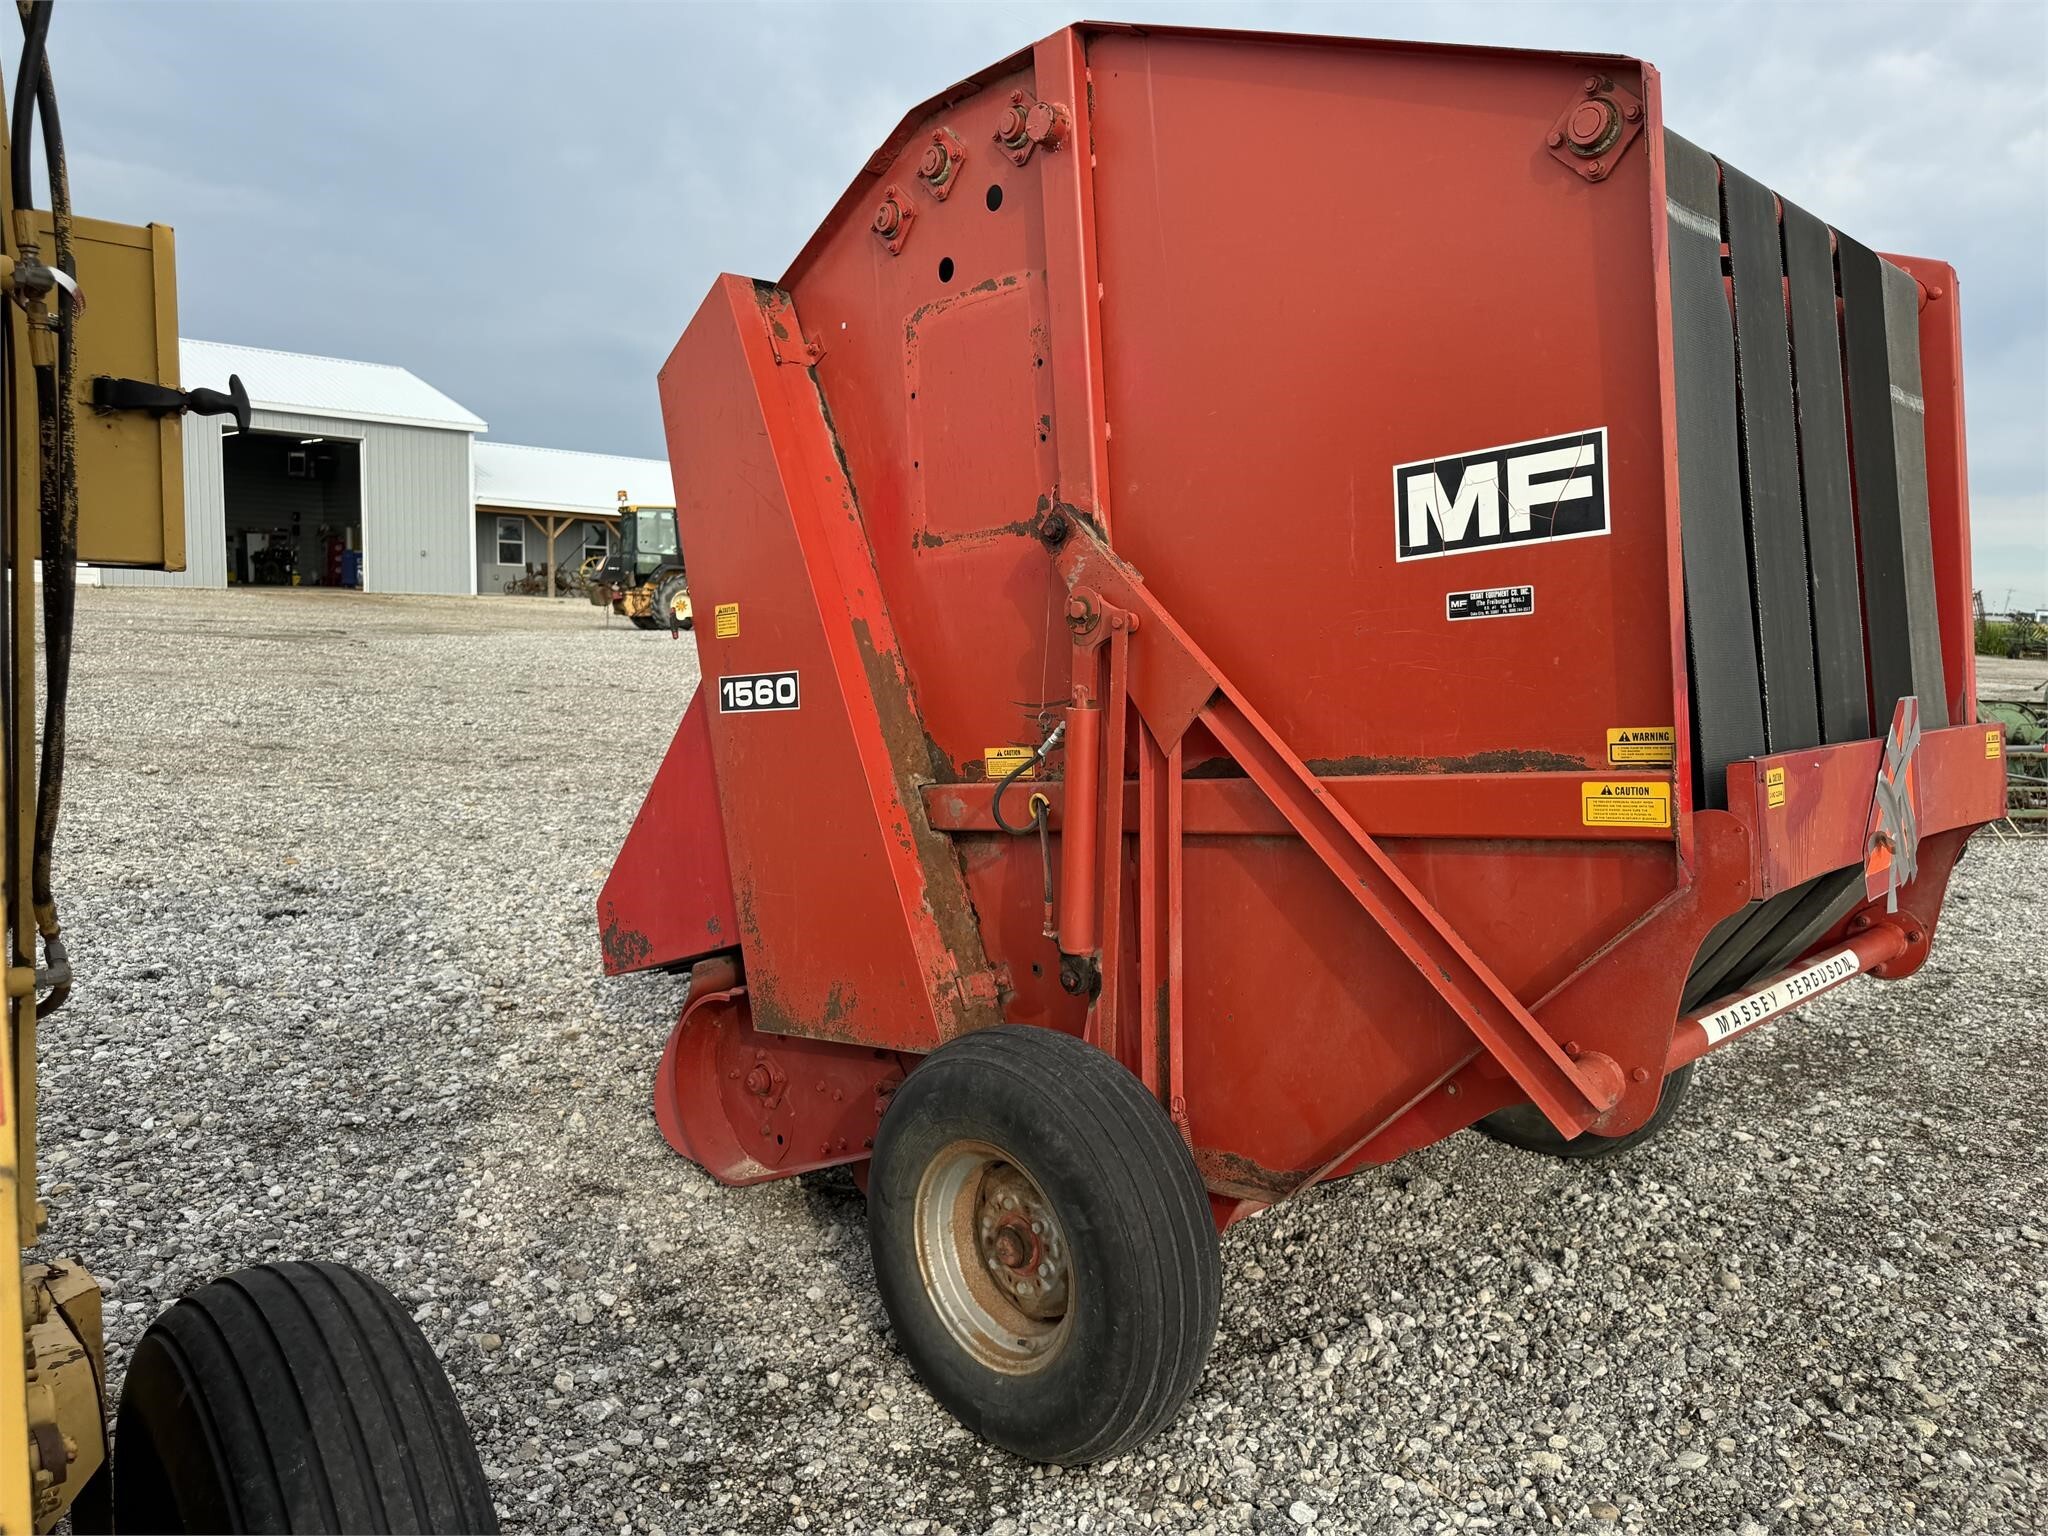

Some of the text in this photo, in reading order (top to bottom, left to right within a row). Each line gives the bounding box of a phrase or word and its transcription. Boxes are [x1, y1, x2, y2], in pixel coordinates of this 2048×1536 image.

[1407, 444, 1595, 547] MF
[1450, 600, 1467, 608] MF
[722, 677, 796, 707] 1560
[1631, 732, 1670, 742] WARNING
[1615, 786, 1650, 796] CAUTION
[1715, 956, 1852, 1035] MASSEY FERGUSON
